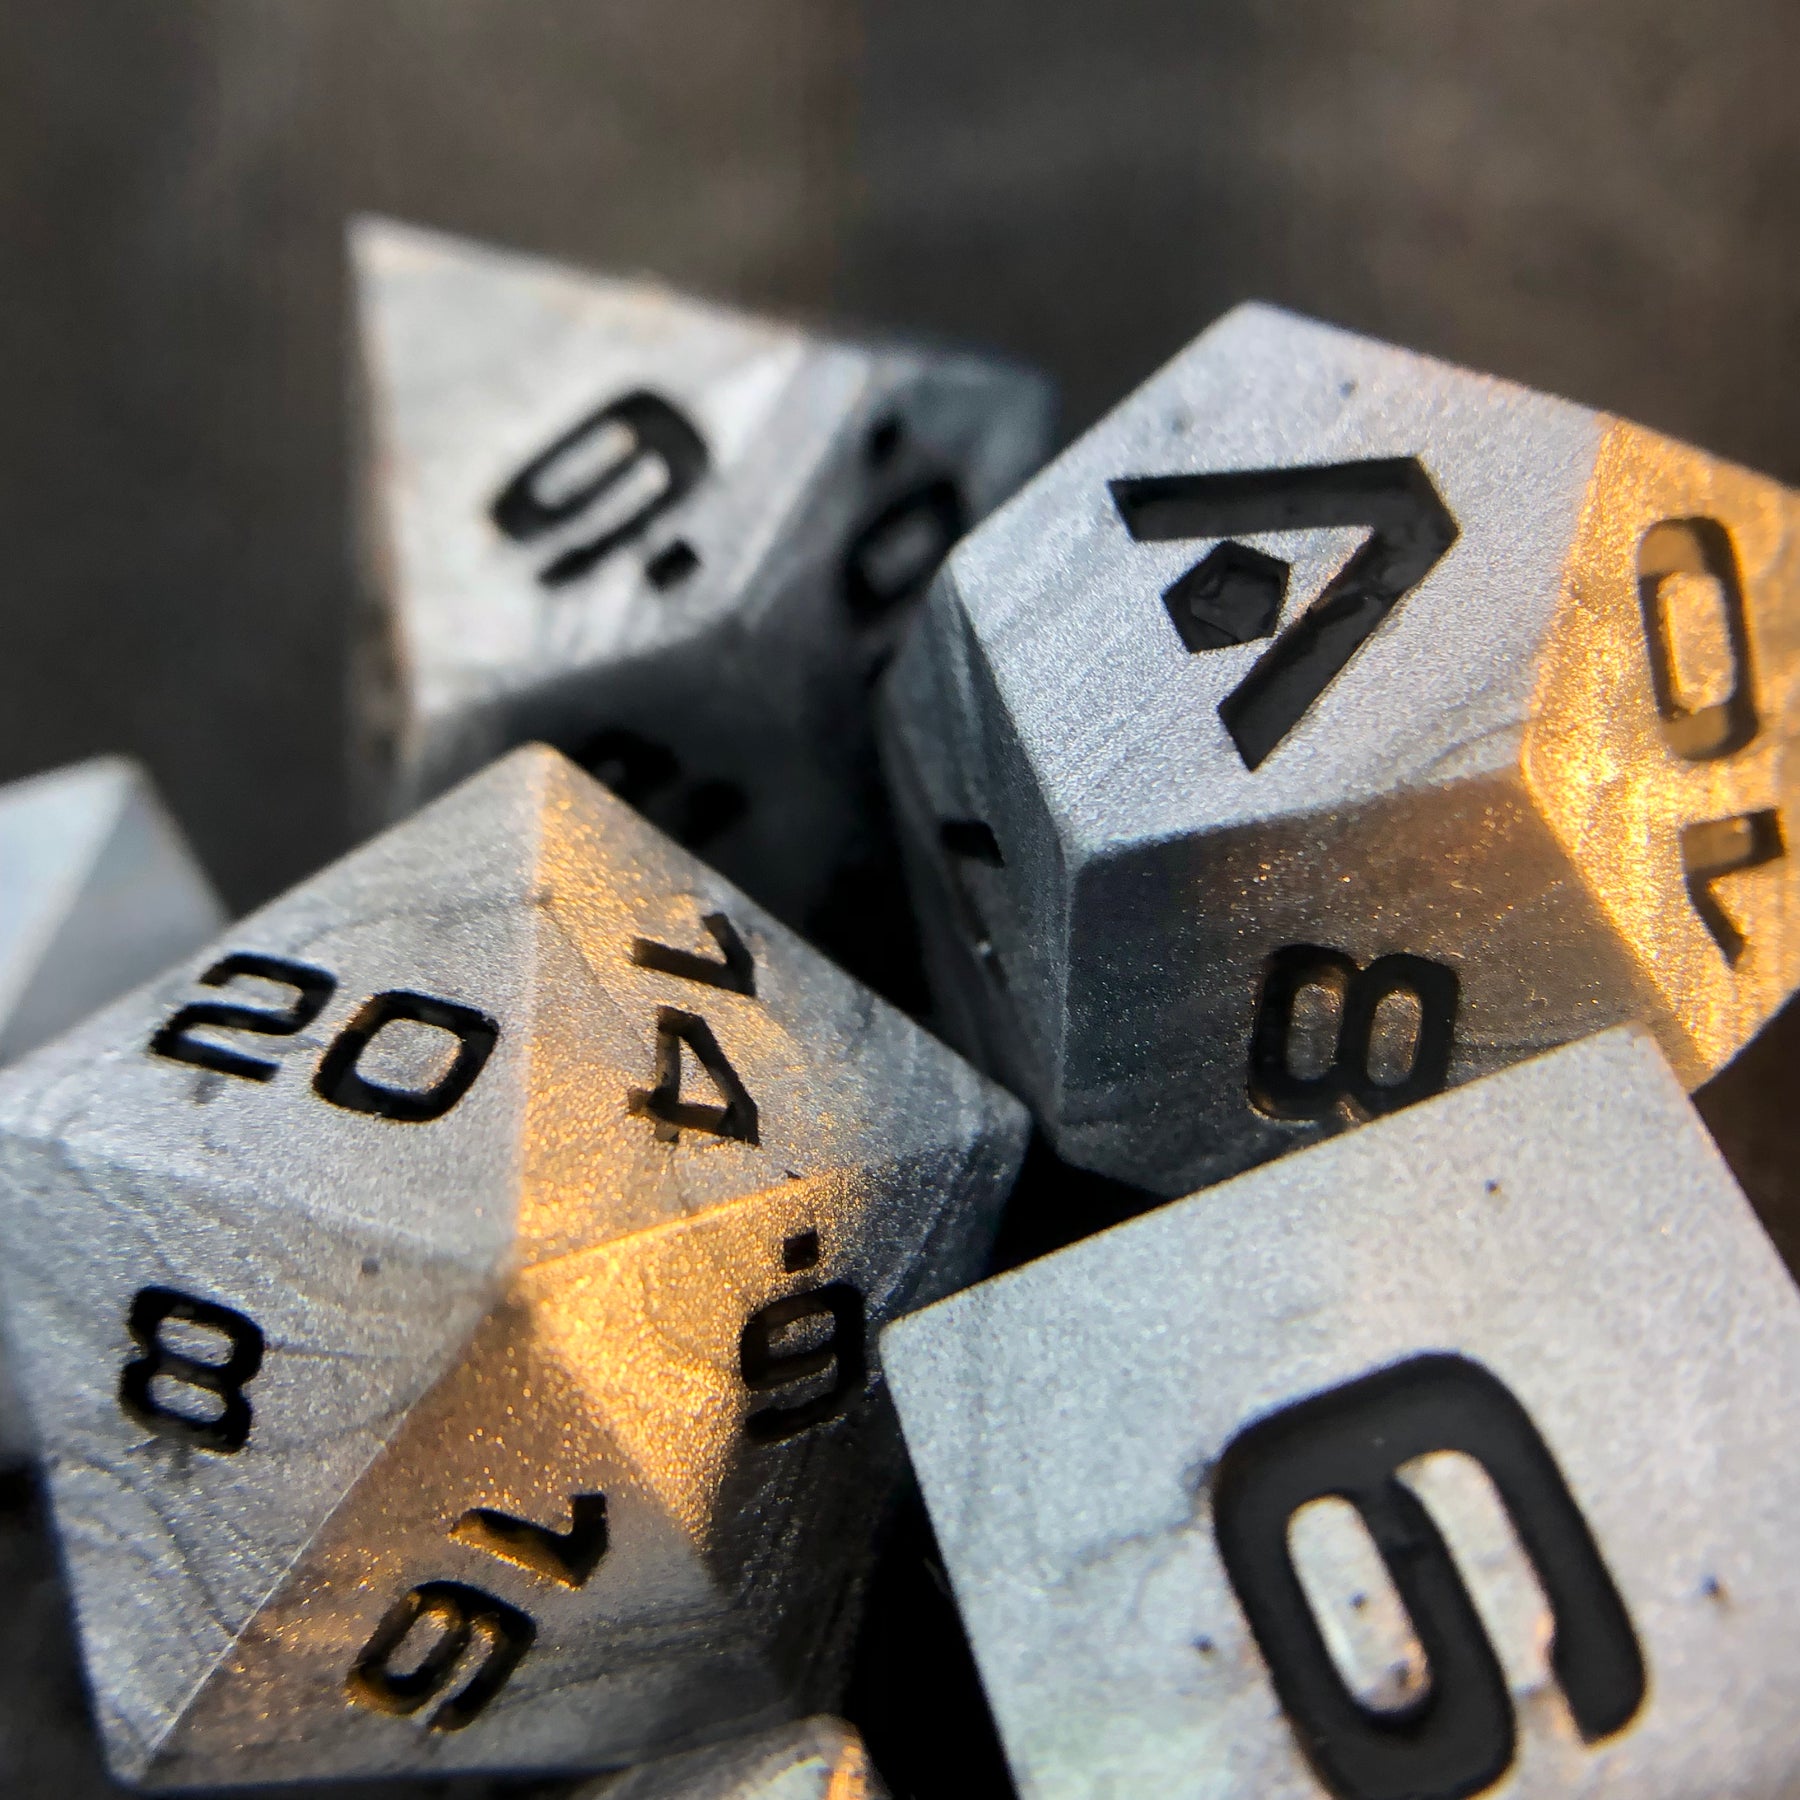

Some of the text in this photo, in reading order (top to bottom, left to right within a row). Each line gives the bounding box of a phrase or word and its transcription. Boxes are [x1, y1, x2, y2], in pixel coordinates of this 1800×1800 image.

[148, 950, 501, 1124] 20
[629, 911, 760, 1147] 14
[1247, 942, 1462, 1125] 8
[119, 1283, 265, 1454] 8
[344, 1491, 609, 1735] 16
